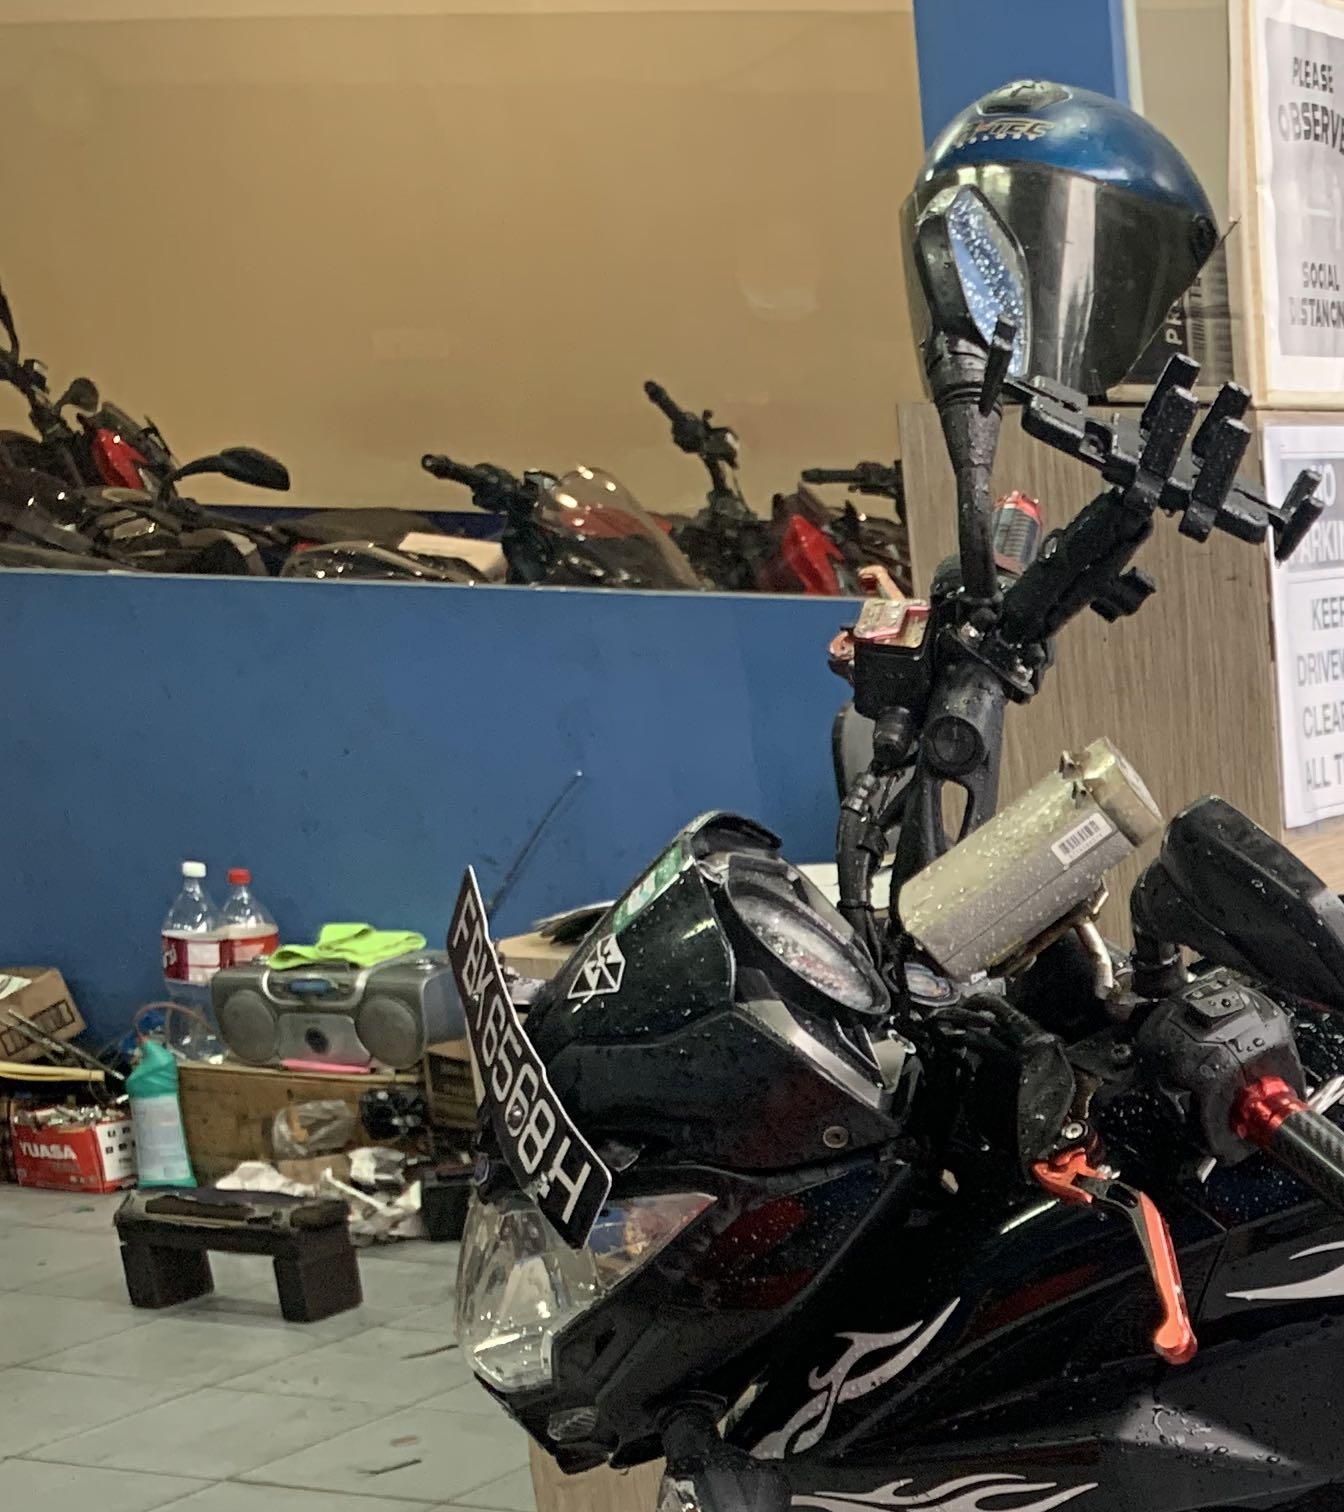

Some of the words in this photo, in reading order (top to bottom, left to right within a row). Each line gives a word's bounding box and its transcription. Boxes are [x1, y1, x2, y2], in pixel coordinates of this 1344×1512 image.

[1292, 57, 1334, 94] PLEASE
[1302, 261, 1340, 292] SOCIAL
[1305, 757, 1331, 792] ALL
[453, 889, 592, 1225] FBK6568H
[19, 1141, 78, 1161] YUASA
